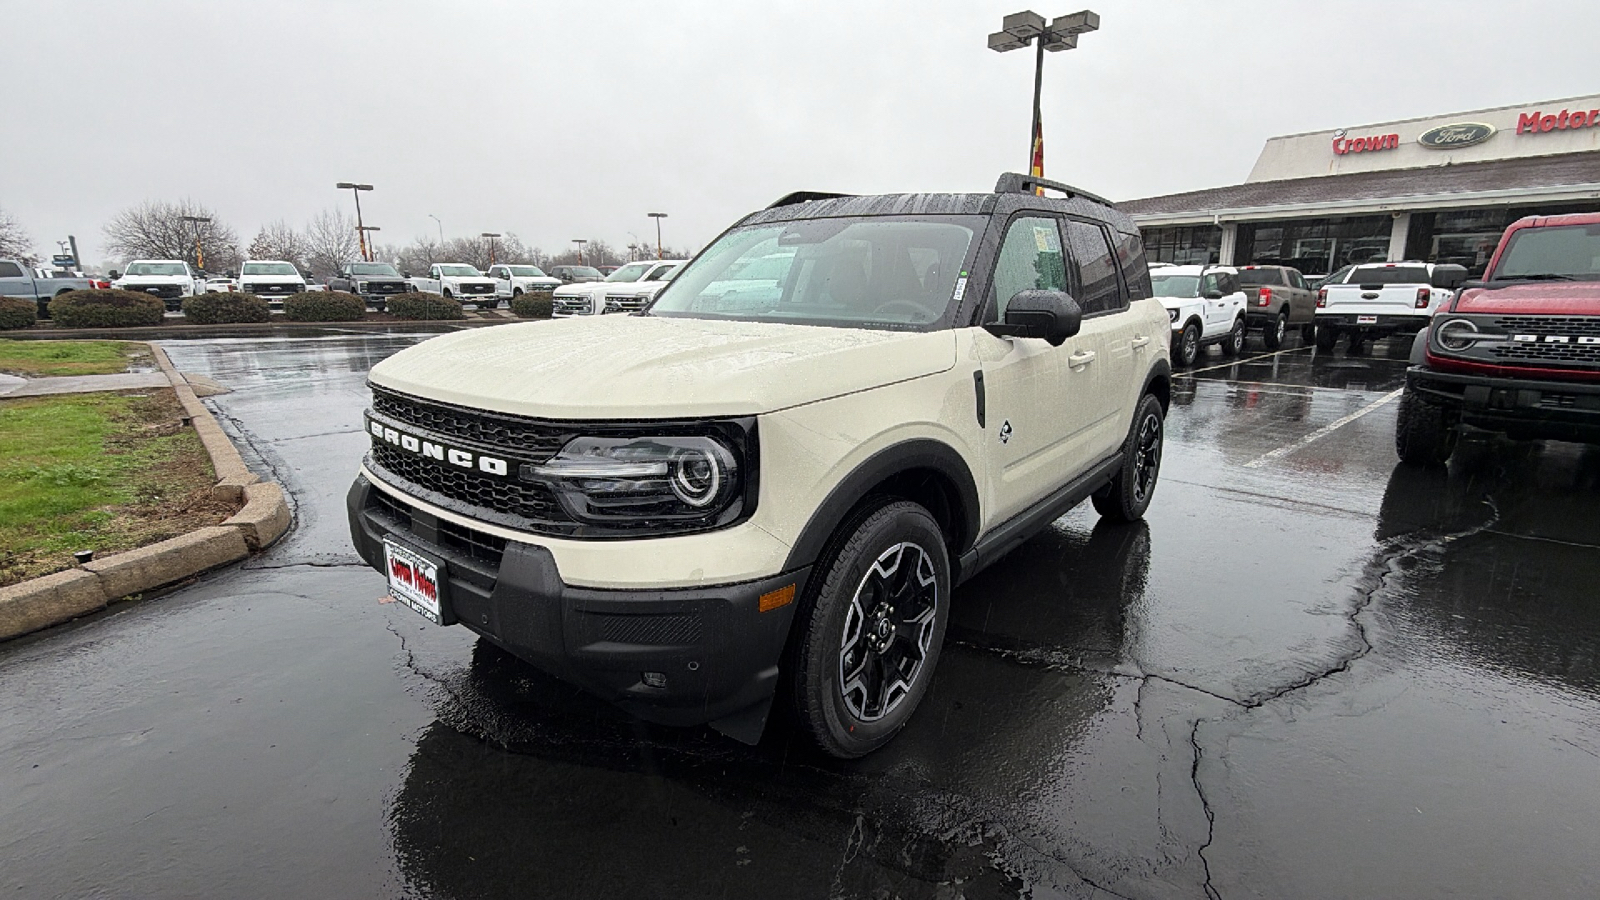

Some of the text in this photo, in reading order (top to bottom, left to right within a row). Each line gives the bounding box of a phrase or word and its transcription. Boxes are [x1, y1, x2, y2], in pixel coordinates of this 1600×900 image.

[1332, 109, 1600, 155] Crown Ford Motor
[371, 421, 508, 476] BRONCO
[411, 601, 437, 623] MOTORS
